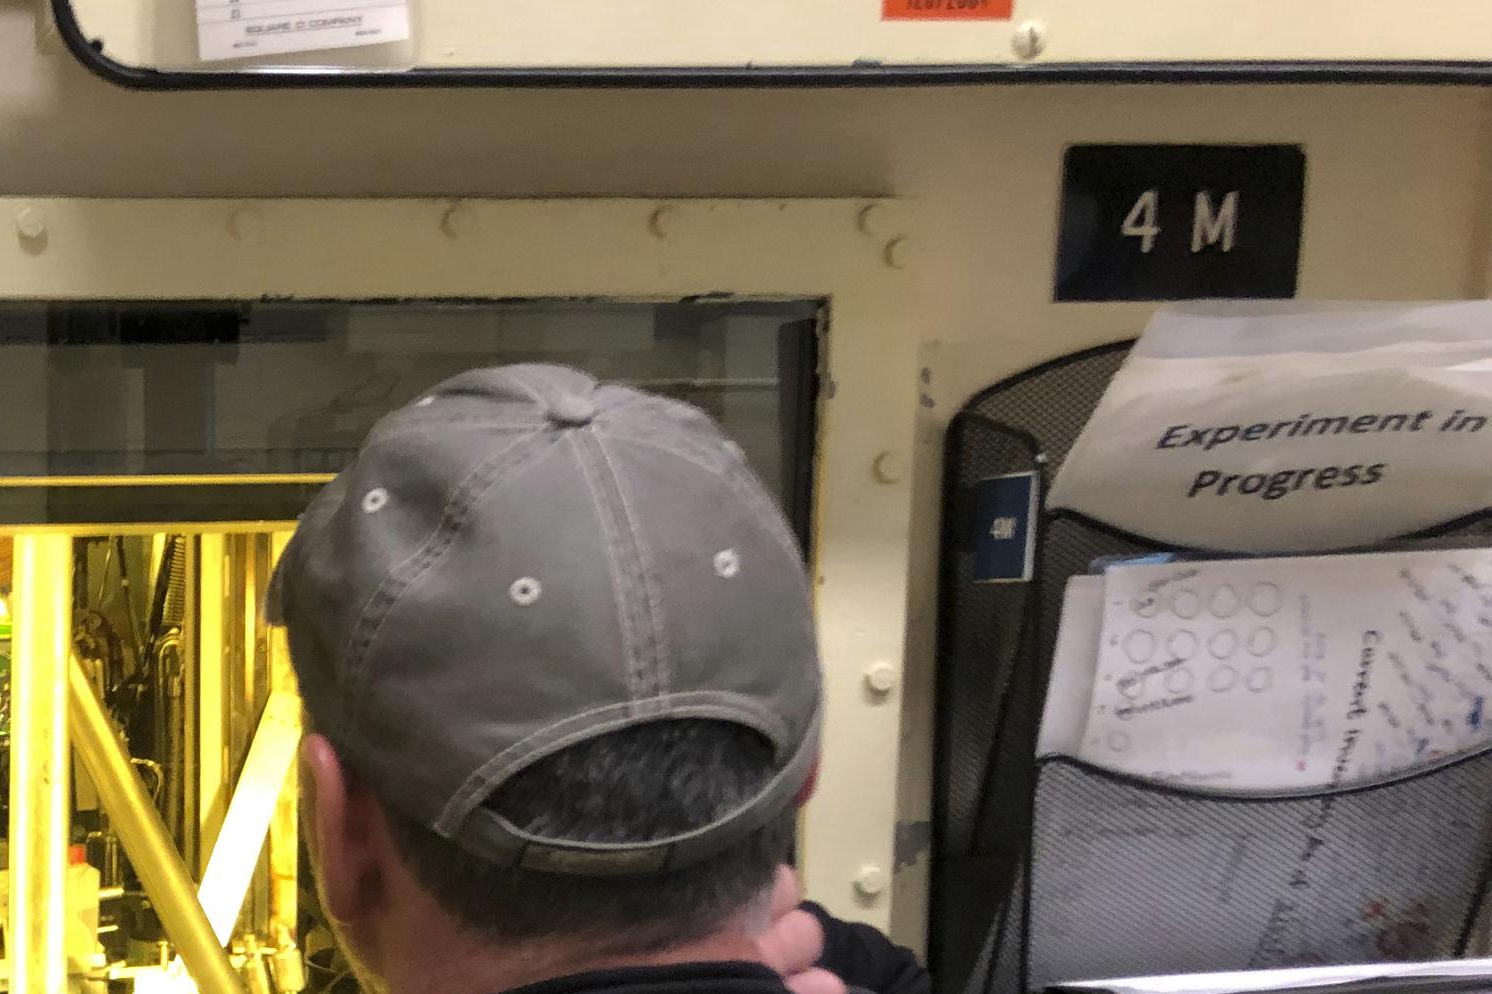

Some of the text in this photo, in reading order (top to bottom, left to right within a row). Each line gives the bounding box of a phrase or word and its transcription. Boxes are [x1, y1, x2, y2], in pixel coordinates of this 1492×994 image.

[1121, 190, 1240, 254] 4 M
[1155, 409, 1490, 451] Experiment in
[1186, 462, 1388, 500] Progress
